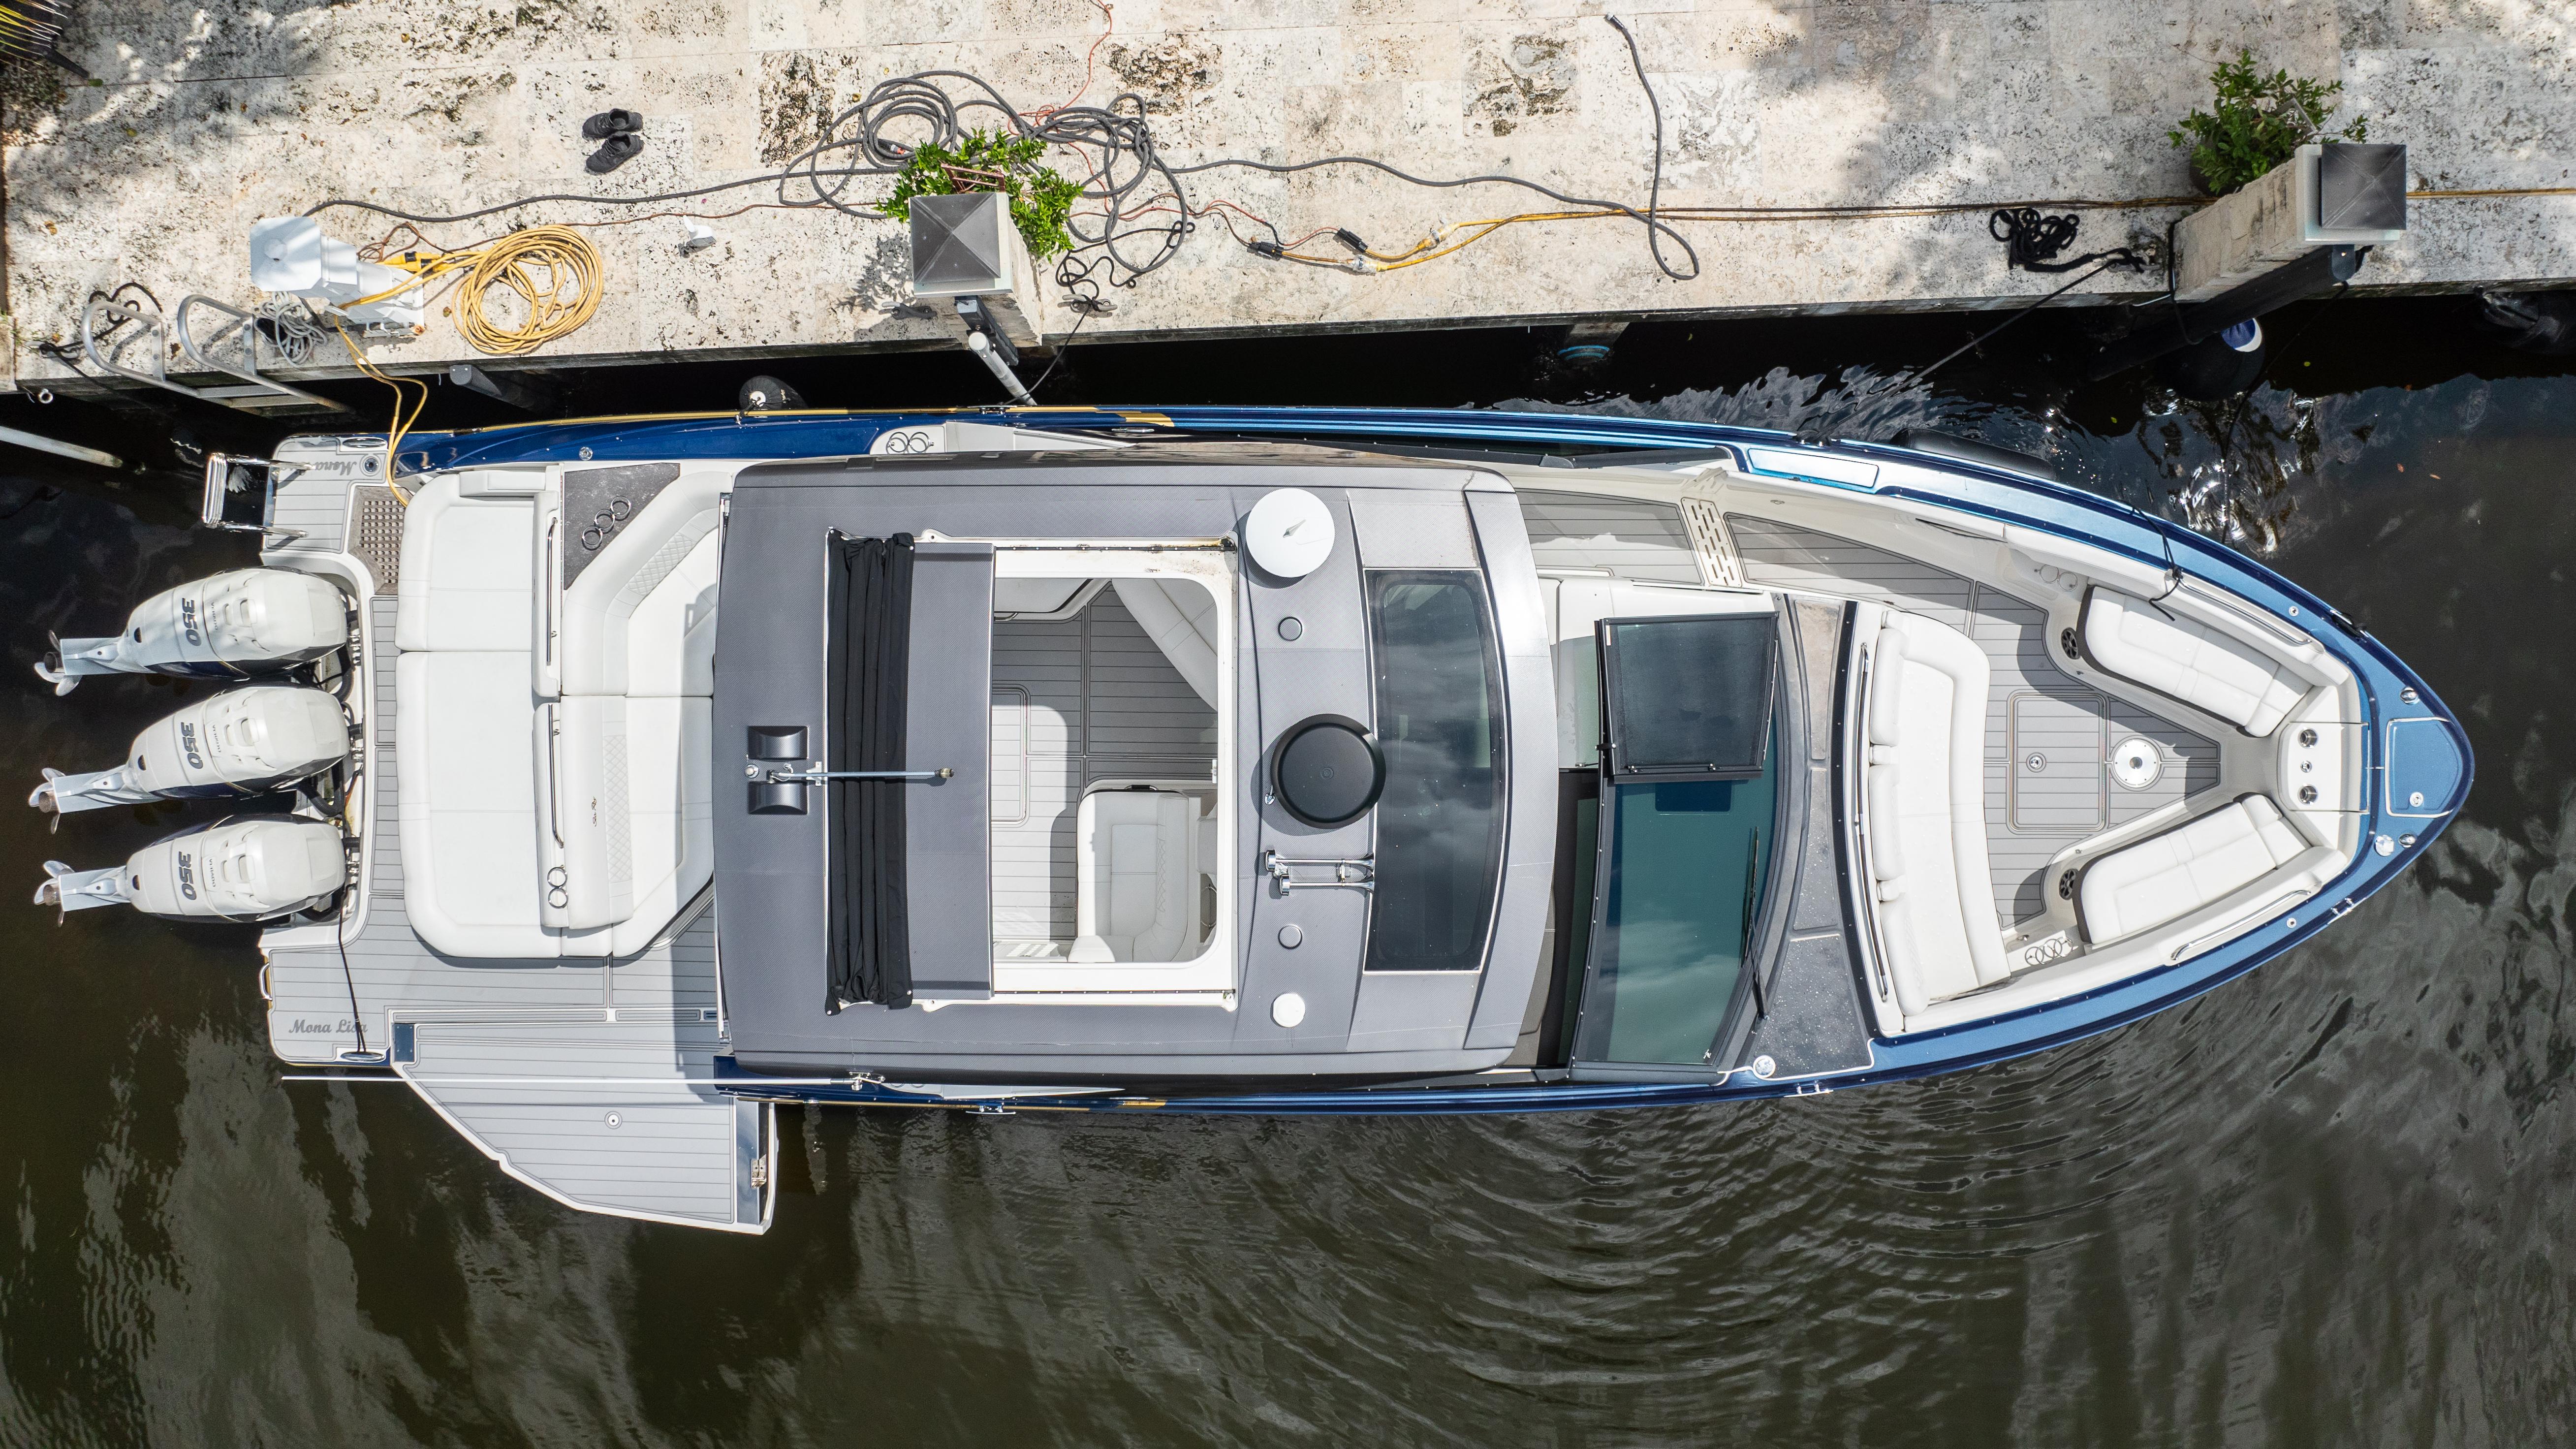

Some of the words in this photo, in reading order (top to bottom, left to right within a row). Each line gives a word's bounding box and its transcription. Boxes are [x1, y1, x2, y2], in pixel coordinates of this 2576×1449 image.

[314, 461, 357, 476] Mona
[182, 598, 202, 646] 350
[181, 722, 203, 769] 350
[178, 851, 197, 900] 350
[288, 1019, 332, 1033] Mona
